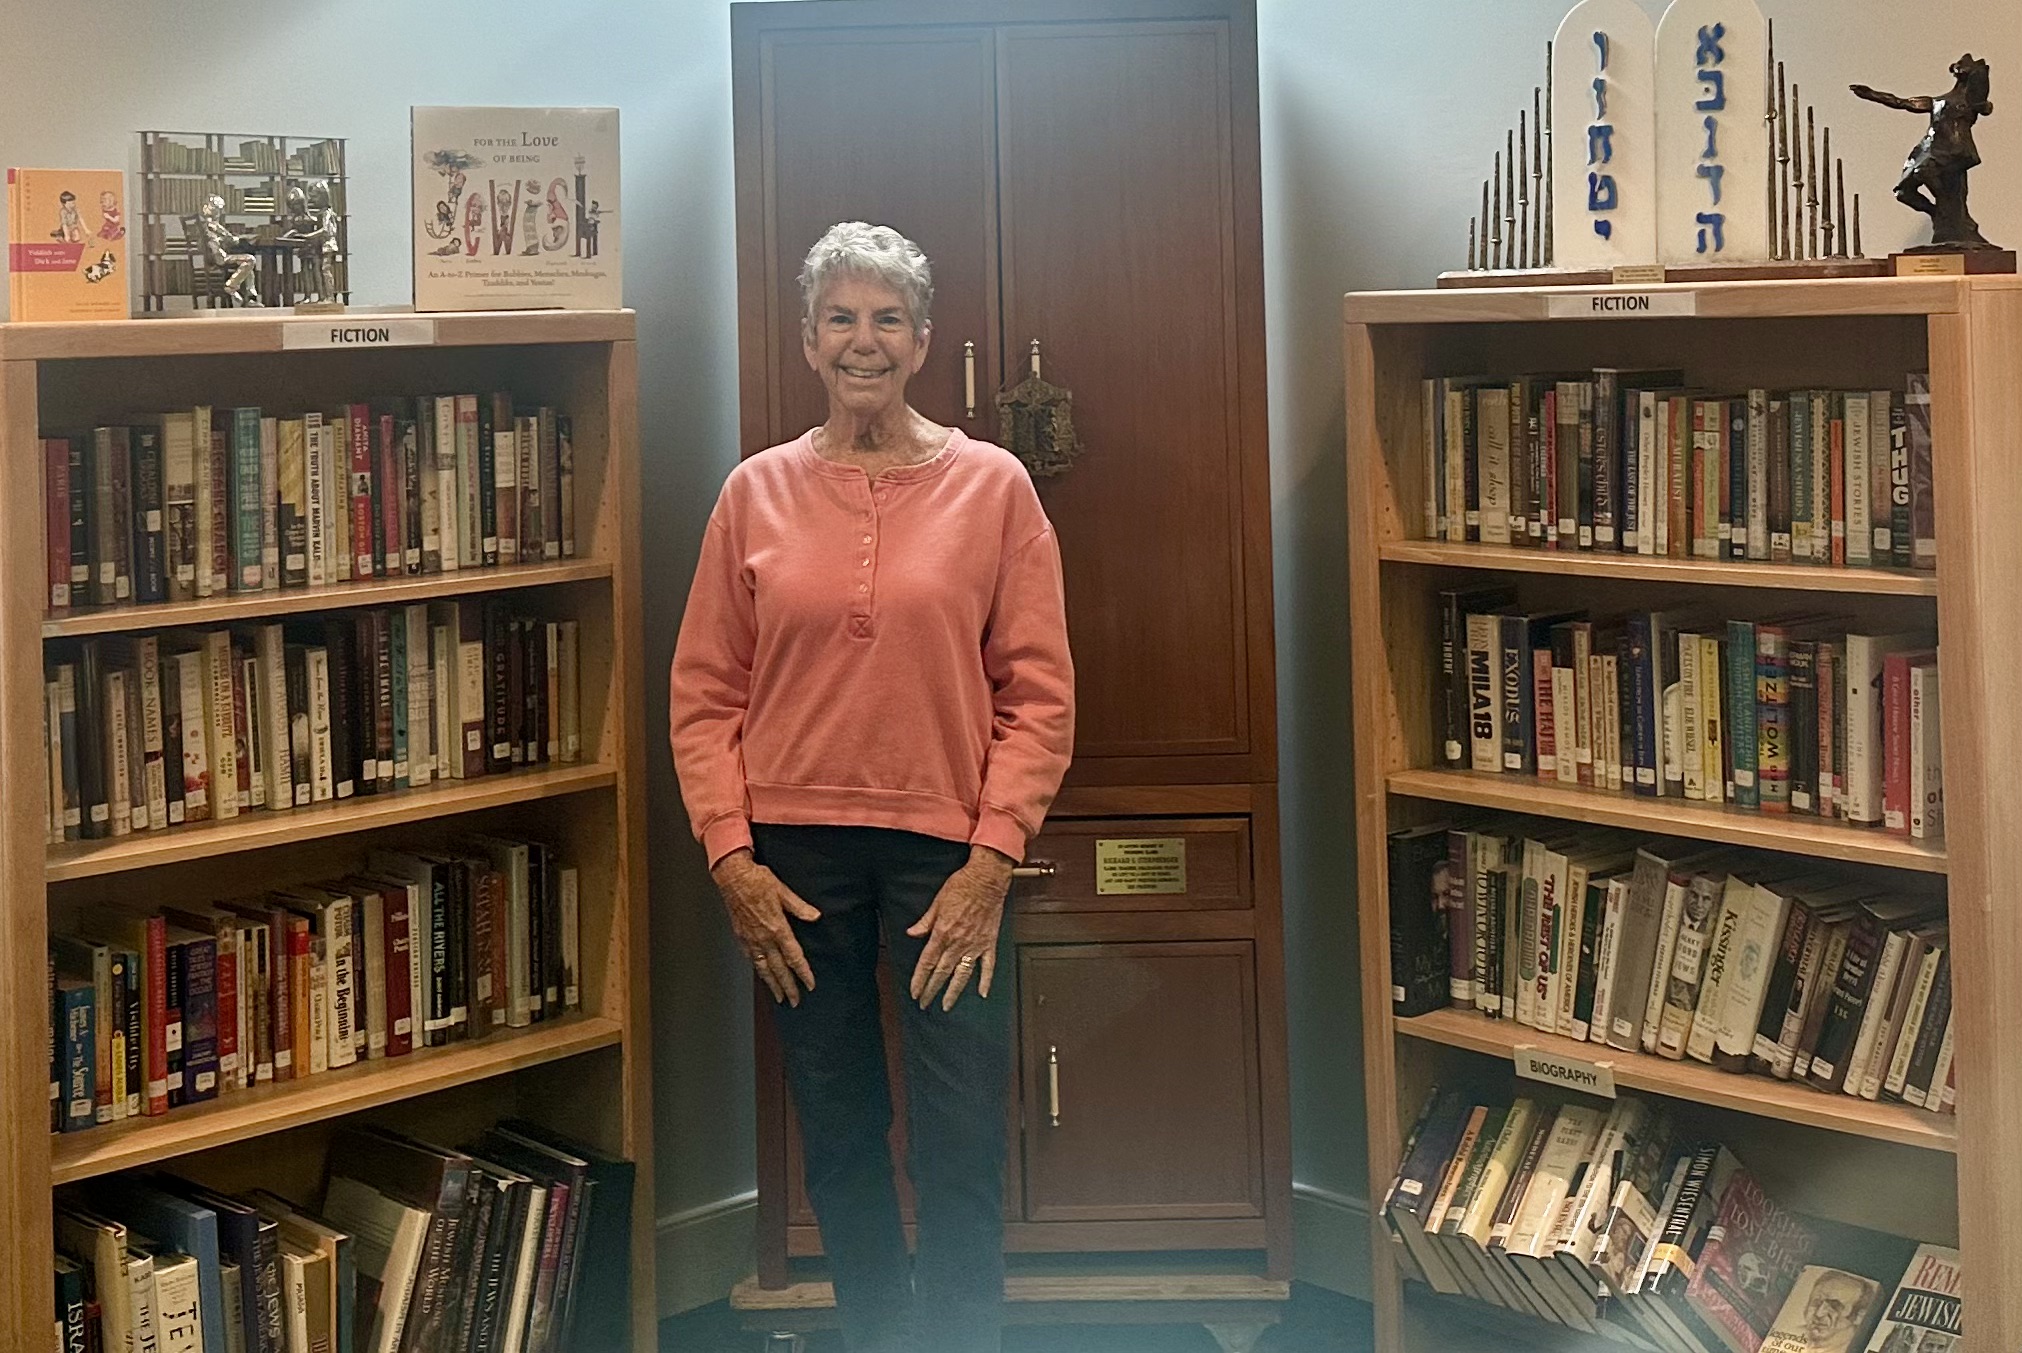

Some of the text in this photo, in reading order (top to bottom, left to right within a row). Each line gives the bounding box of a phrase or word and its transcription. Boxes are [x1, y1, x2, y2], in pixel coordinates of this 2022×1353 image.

[473, 131, 559, 147] FOR THE Love
[509, 155, 540, 163] BEING
[1591, 295, 1650, 313] FICTION
[330, 327, 390, 345] FICTION
[309, 431, 319, 449] THE
[354, 418, 364, 460] DIAMANT
[362, 424, 370, 451] ANITA
[310, 450, 320, 477] TRUTH
[1486, 425, 1503, 505] call it sleep
[1627, 449, 1637, 464] THE
[1891, 426, 1909, 505] THUG
[1627, 465, 1637, 484] LAST
[1672, 447, 1683, 502] MURALIST
[1852, 421, 1863, 526] JEWISH STORIES
[311, 478, 321, 506] ABOUT
[1628, 497, 1637, 512] THE
[312, 507, 322, 538] MARVIN
[357, 503, 366, 539] BOSTON
[496, 652, 506, 735] GRATITUDE
[1471, 650, 1493, 740] MILA 18
[1504, 647, 1521, 724] EXODUS
[1538, 679, 1553, 706] THE
[145, 695, 159, 744] NAMES
[1764, 656, 1778, 758] WOLITZER
[1913, 689, 1921, 720] other
[1570, 878, 1579, 905] JEWISH
[433, 882, 446, 973] ALL THE RIVERS
[1568, 906, 1577, 931] HEROES
[1709, 908, 1739, 988] Kissinger
[336, 968, 349, 986] the
[1563, 982, 1573, 1014] AMERICA
[334, 987, 351, 1041] Beginnin
[1529, 1059, 1598, 1087] BIOGRAPHY
[1666, 1147, 1715, 1236] SIMON WIESENTHAL
[430, 1240, 441, 1262] THE
[431, 1218, 460, 1329] JEWISH MUSEUMS
[421, 1267, 440, 1315] WORLD
